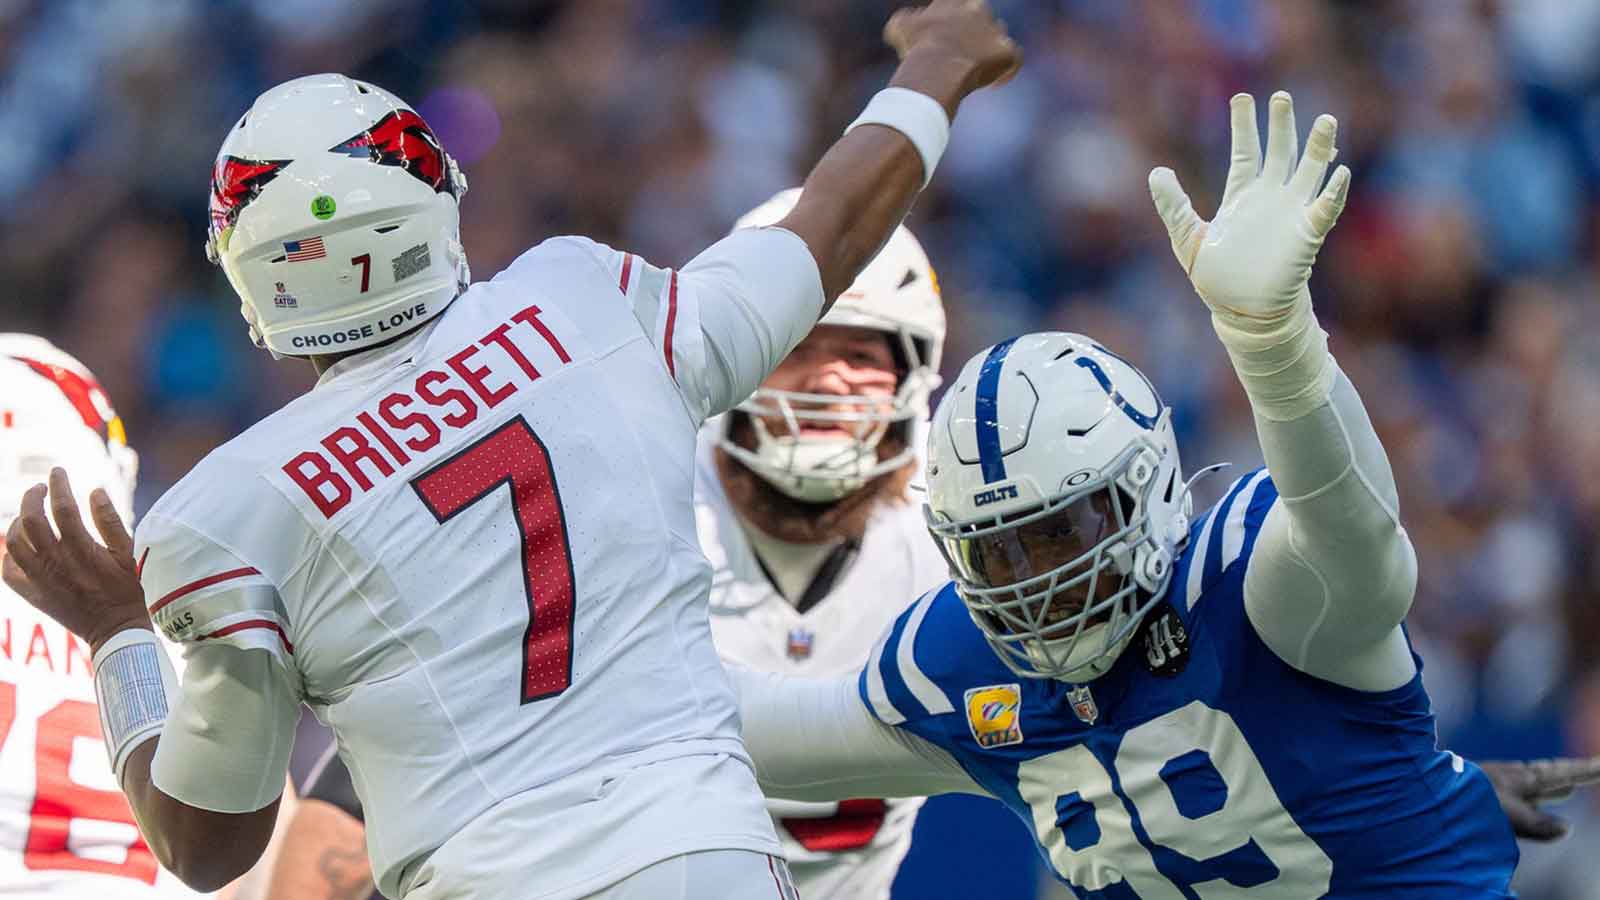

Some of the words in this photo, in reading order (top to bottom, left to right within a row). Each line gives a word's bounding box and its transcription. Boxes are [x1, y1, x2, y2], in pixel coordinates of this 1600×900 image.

[291, 324, 375, 349] CHOOSE
[378, 303, 428, 333] LOVE
[351, 253, 371, 294] 7
[281, 304, 573, 520] BRISSETT
[973, 484, 1019, 508] COLTS
[408, 413, 577, 706] 7
[1017, 700, 1334, 900] 99
